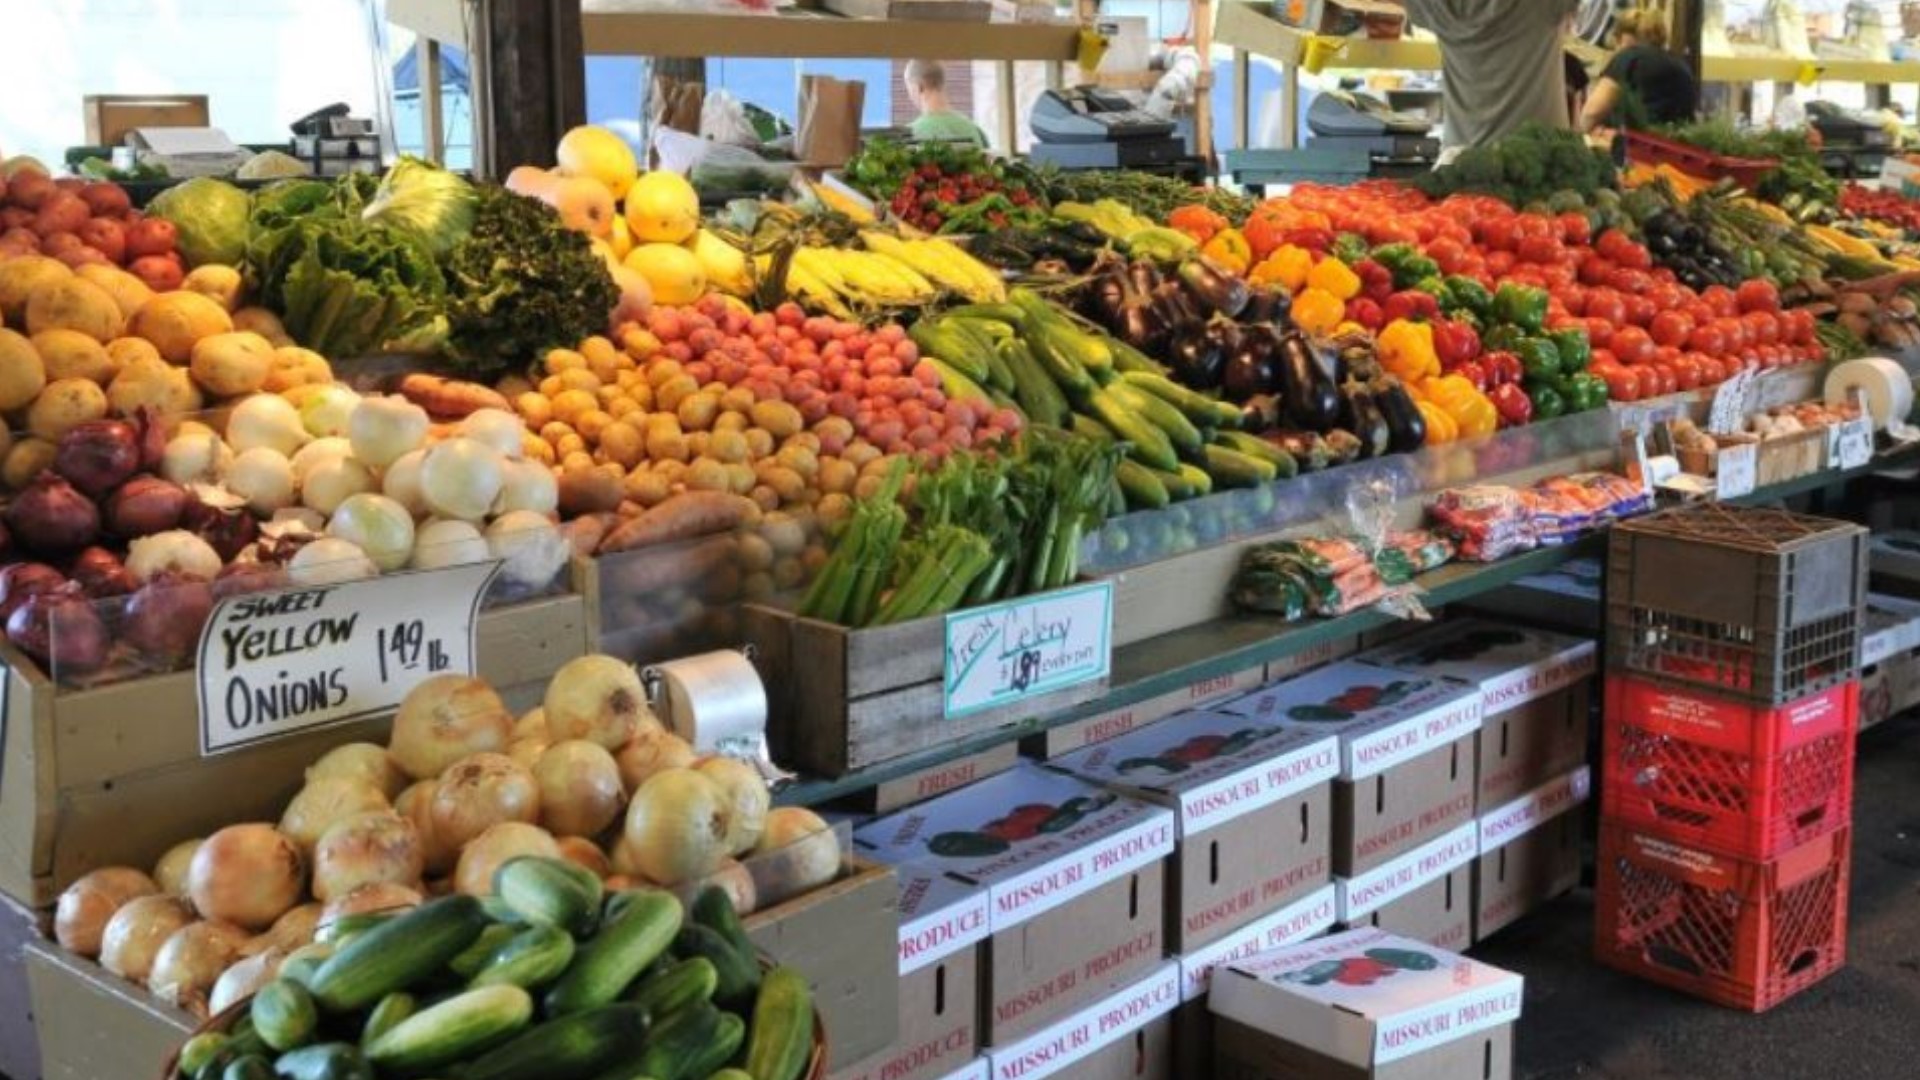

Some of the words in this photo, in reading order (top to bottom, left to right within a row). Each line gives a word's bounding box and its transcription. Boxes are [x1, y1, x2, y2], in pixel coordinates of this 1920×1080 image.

[228, 589, 330, 622] SWEET
[1083, 712, 1133, 743] FRESH
[1356, 729, 1418, 764] MISSOURI
[1425, 702, 1478, 739] PRODUCE
[918, 762, 976, 795] FRESH
[1186, 778, 1260, 819] MISSOURI
[1267, 747, 1334, 789] PRODUCE
[1356, 820, 1413, 857] MISSOURI
[1418, 792, 1470, 832] PRODUCE
[998, 862, 1083, 914] MISSOURI
[1092, 824, 1170, 874] PRODUCE
[1186, 887, 1255, 932] MISSOURI
[1262, 856, 1325, 900] PRODUCE
[1352, 866, 1412, 907] MISSOURI
[1418, 835, 1474, 876] PRODUCE
[1267, 901, 1331, 945] PRODUCE
[997, 970, 1076, 1021] MISSOURI
[1084, 931, 1155, 979] PRODUCE
[1002, 1025, 1089, 1079] MISSOURI
[1099, 979, 1175, 1034] PRODUCE
[1382, 1012, 1451, 1048] MISSOURI
[1457, 991, 1518, 1027] PRODUCE
[881, 1025, 968, 1080] PRODUCE
